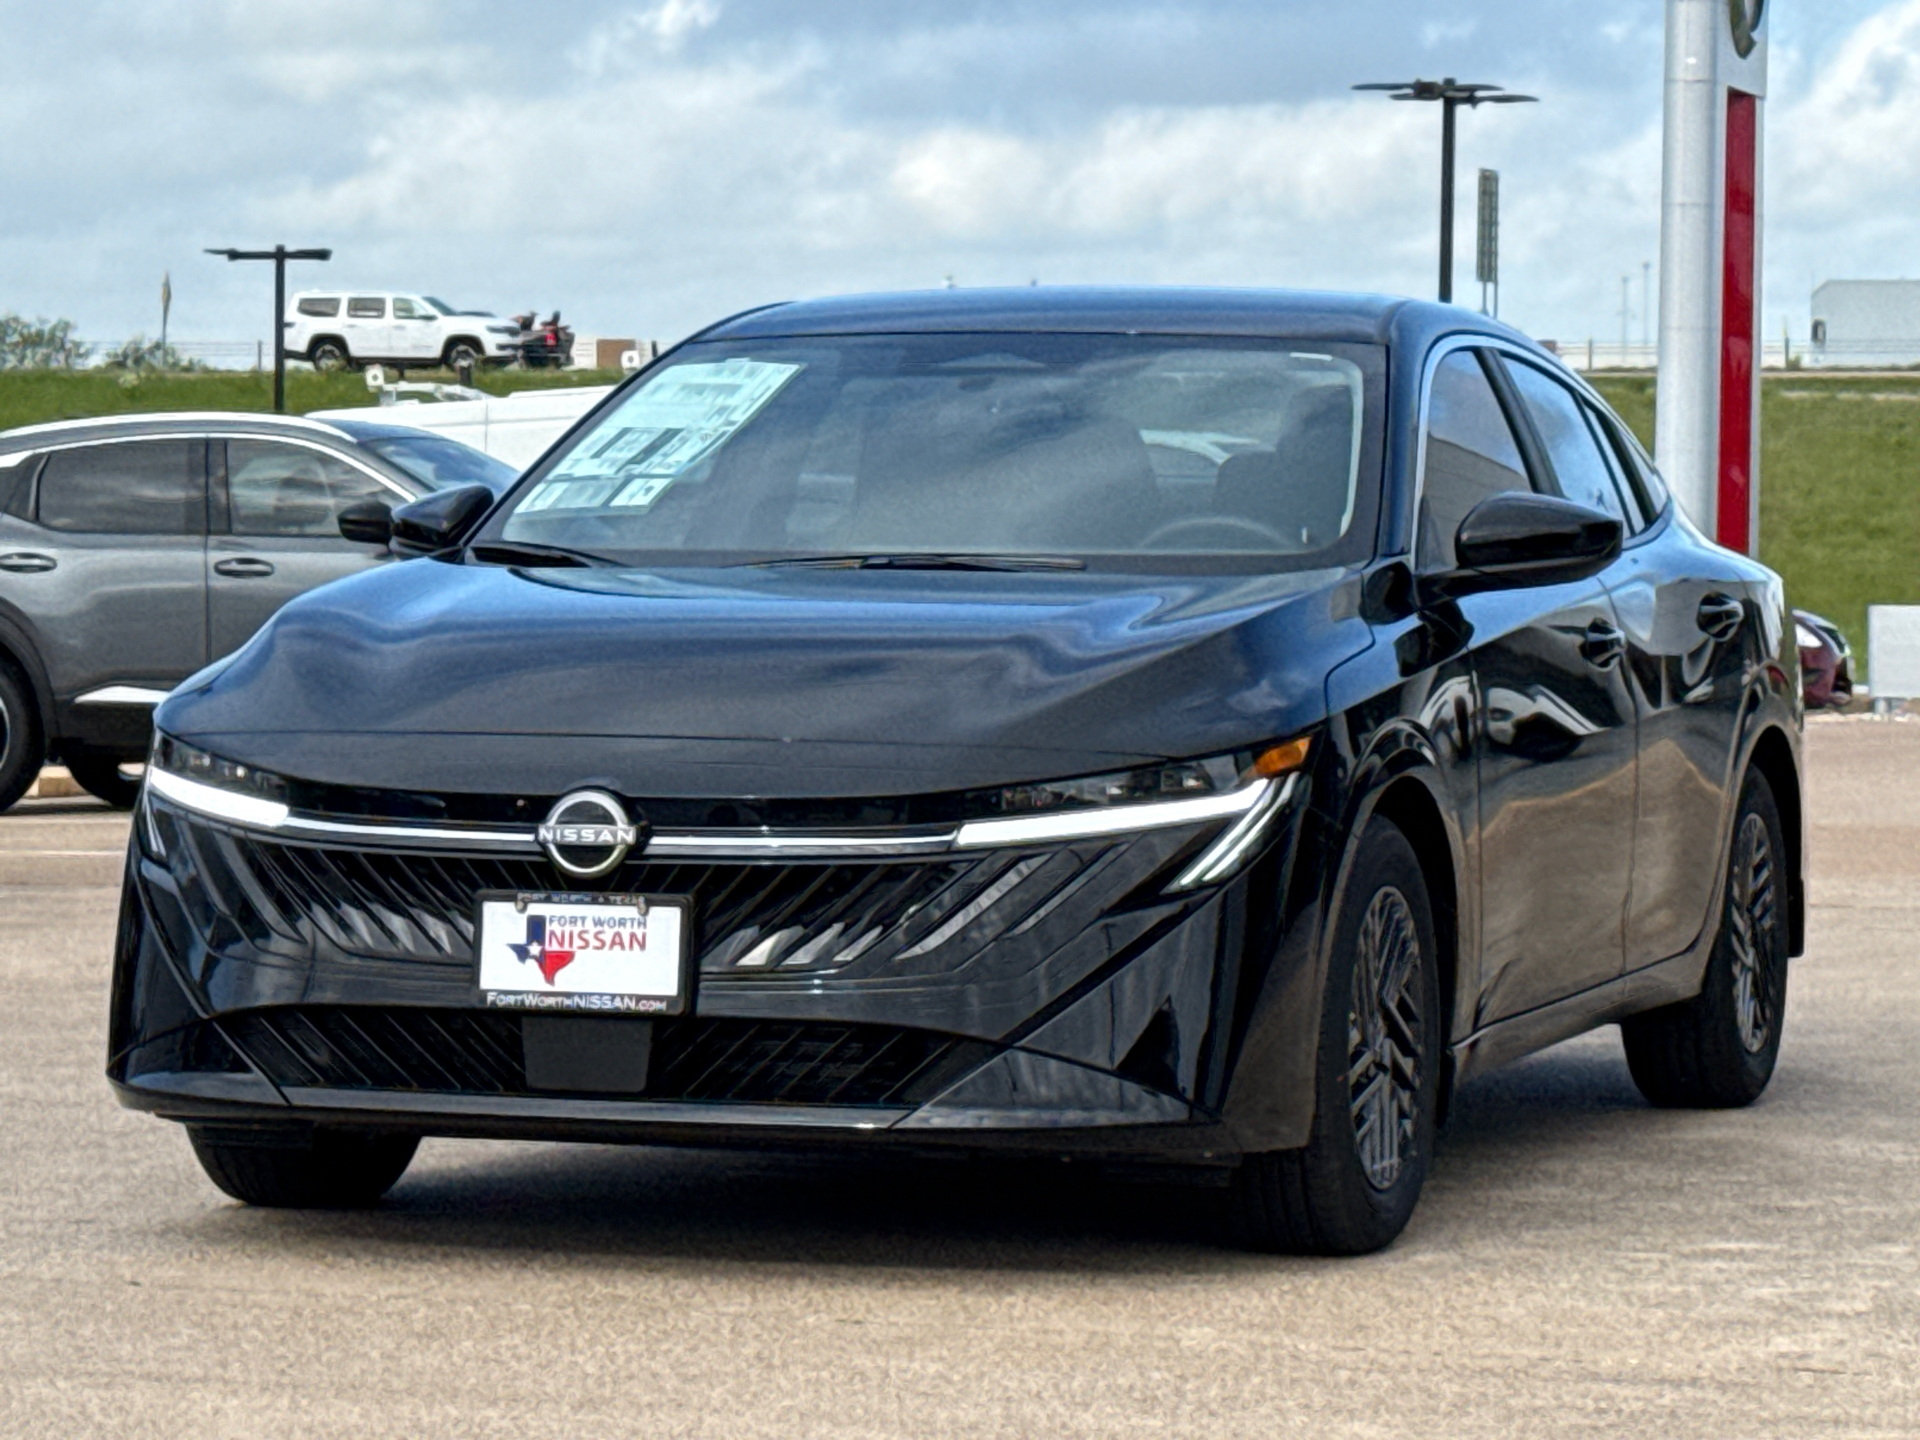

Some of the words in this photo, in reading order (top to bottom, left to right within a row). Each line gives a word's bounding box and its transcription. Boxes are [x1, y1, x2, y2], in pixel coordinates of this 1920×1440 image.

[539, 827, 633, 843] NISSAN
[548, 914, 588, 928] FORT
[591, 915, 648, 930] WORTH
[547, 928, 648, 951] NISSAN
